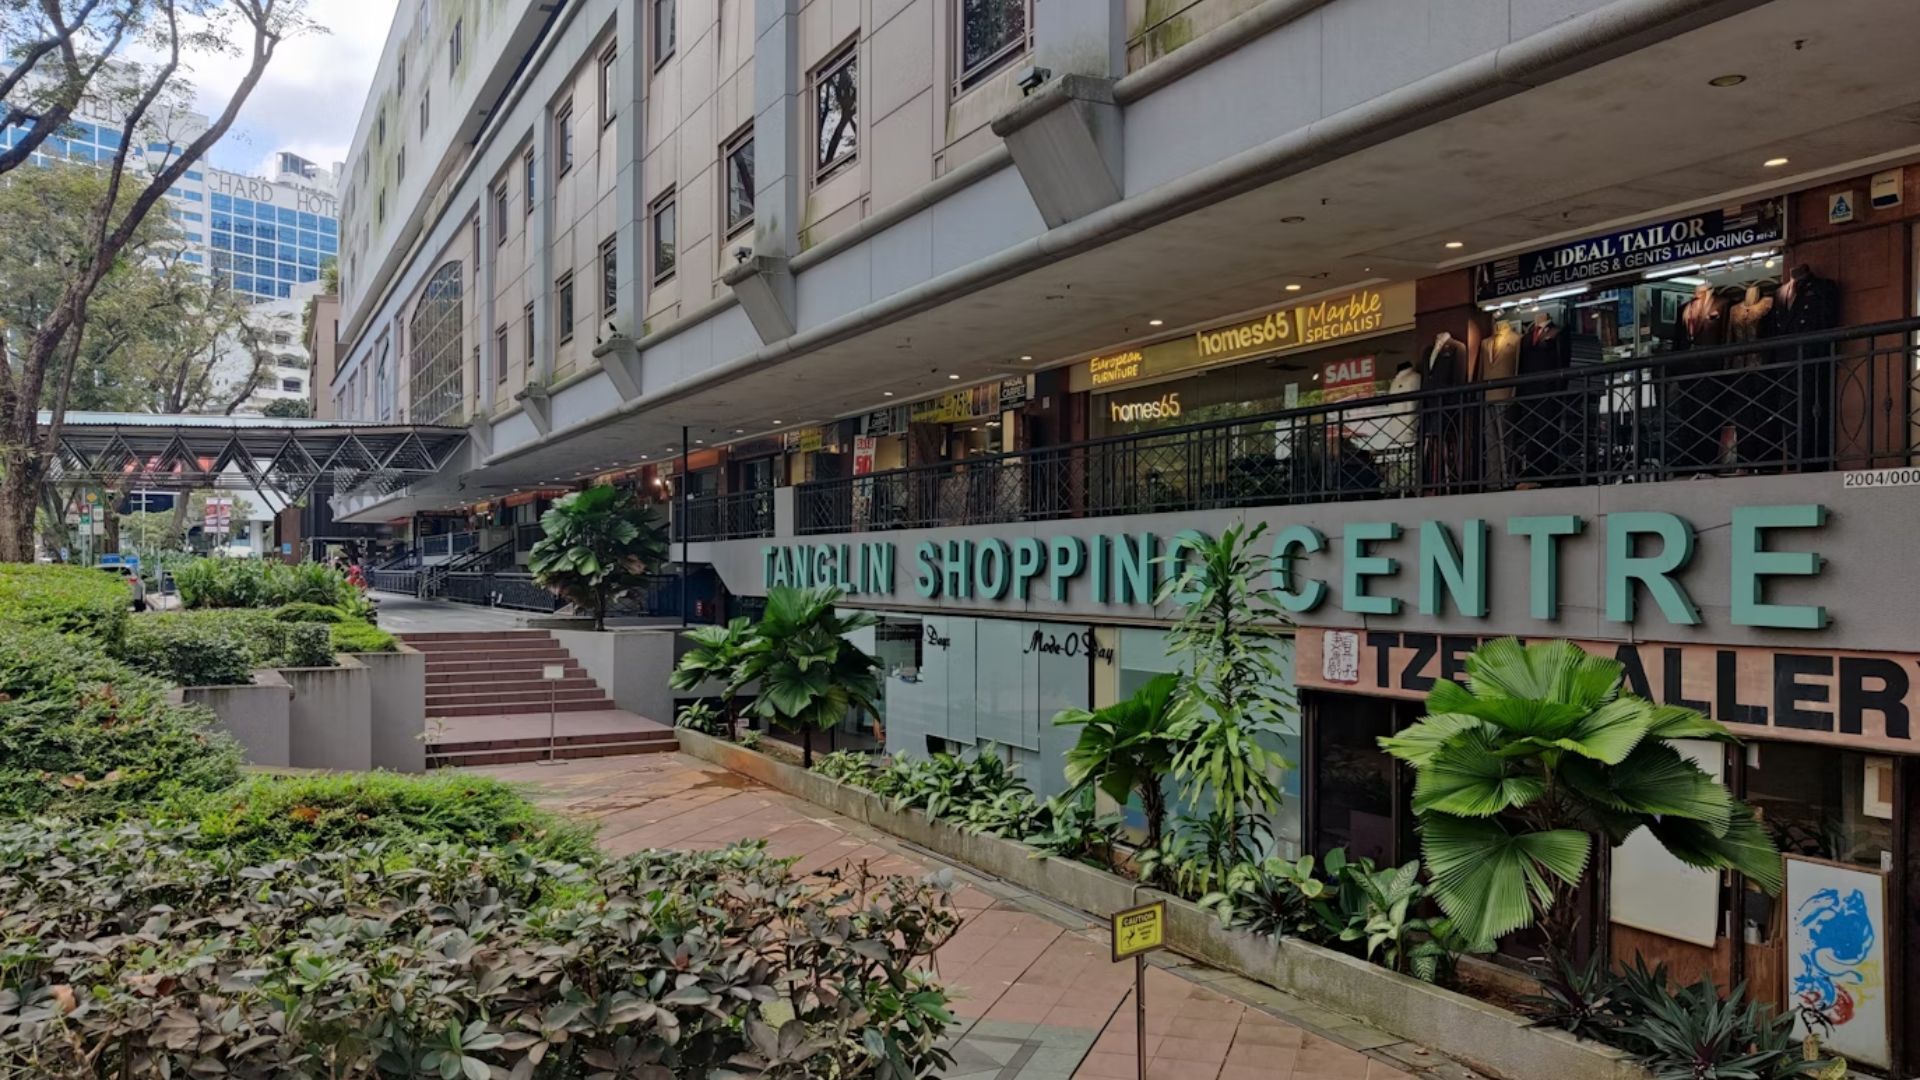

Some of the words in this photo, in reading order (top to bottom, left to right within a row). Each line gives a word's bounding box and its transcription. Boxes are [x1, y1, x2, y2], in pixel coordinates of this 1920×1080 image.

[1533, 239, 1616, 273] A-IDEAL
[1619, 218, 1705, 253] TAILOR
[1497, 270, 1563, 296] EXCLUSIVE
[1564, 261, 1610, 282] LADIES
[1612, 258, 1621, 271] &
[1624, 246, 1672, 268] GENTS
[1677, 229, 1755, 258] TAILORING
[1307, 290, 1381, 326] Marble
[1197, 312, 1290, 357] homes65
[1305, 313, 1383, 343] SPECIALIST
[1090, 351, 1143, 373] European
[1092, 363, 1139, 385] FURNITURE
[1325, 358, 1374, 385] SALE
[1112, 392, 1181, 422] homes65
[1845, 469, 1920, 486] 2004/000
[761, 541, 896, 595] TANGLIN
[914, 529, 1212, 606] SHOPPING
[1271, 504, 1828, 630] CENTRE
[1366, 632, 1527, 693] TZE
[1123, 912, 1154, 926] CAUTION
